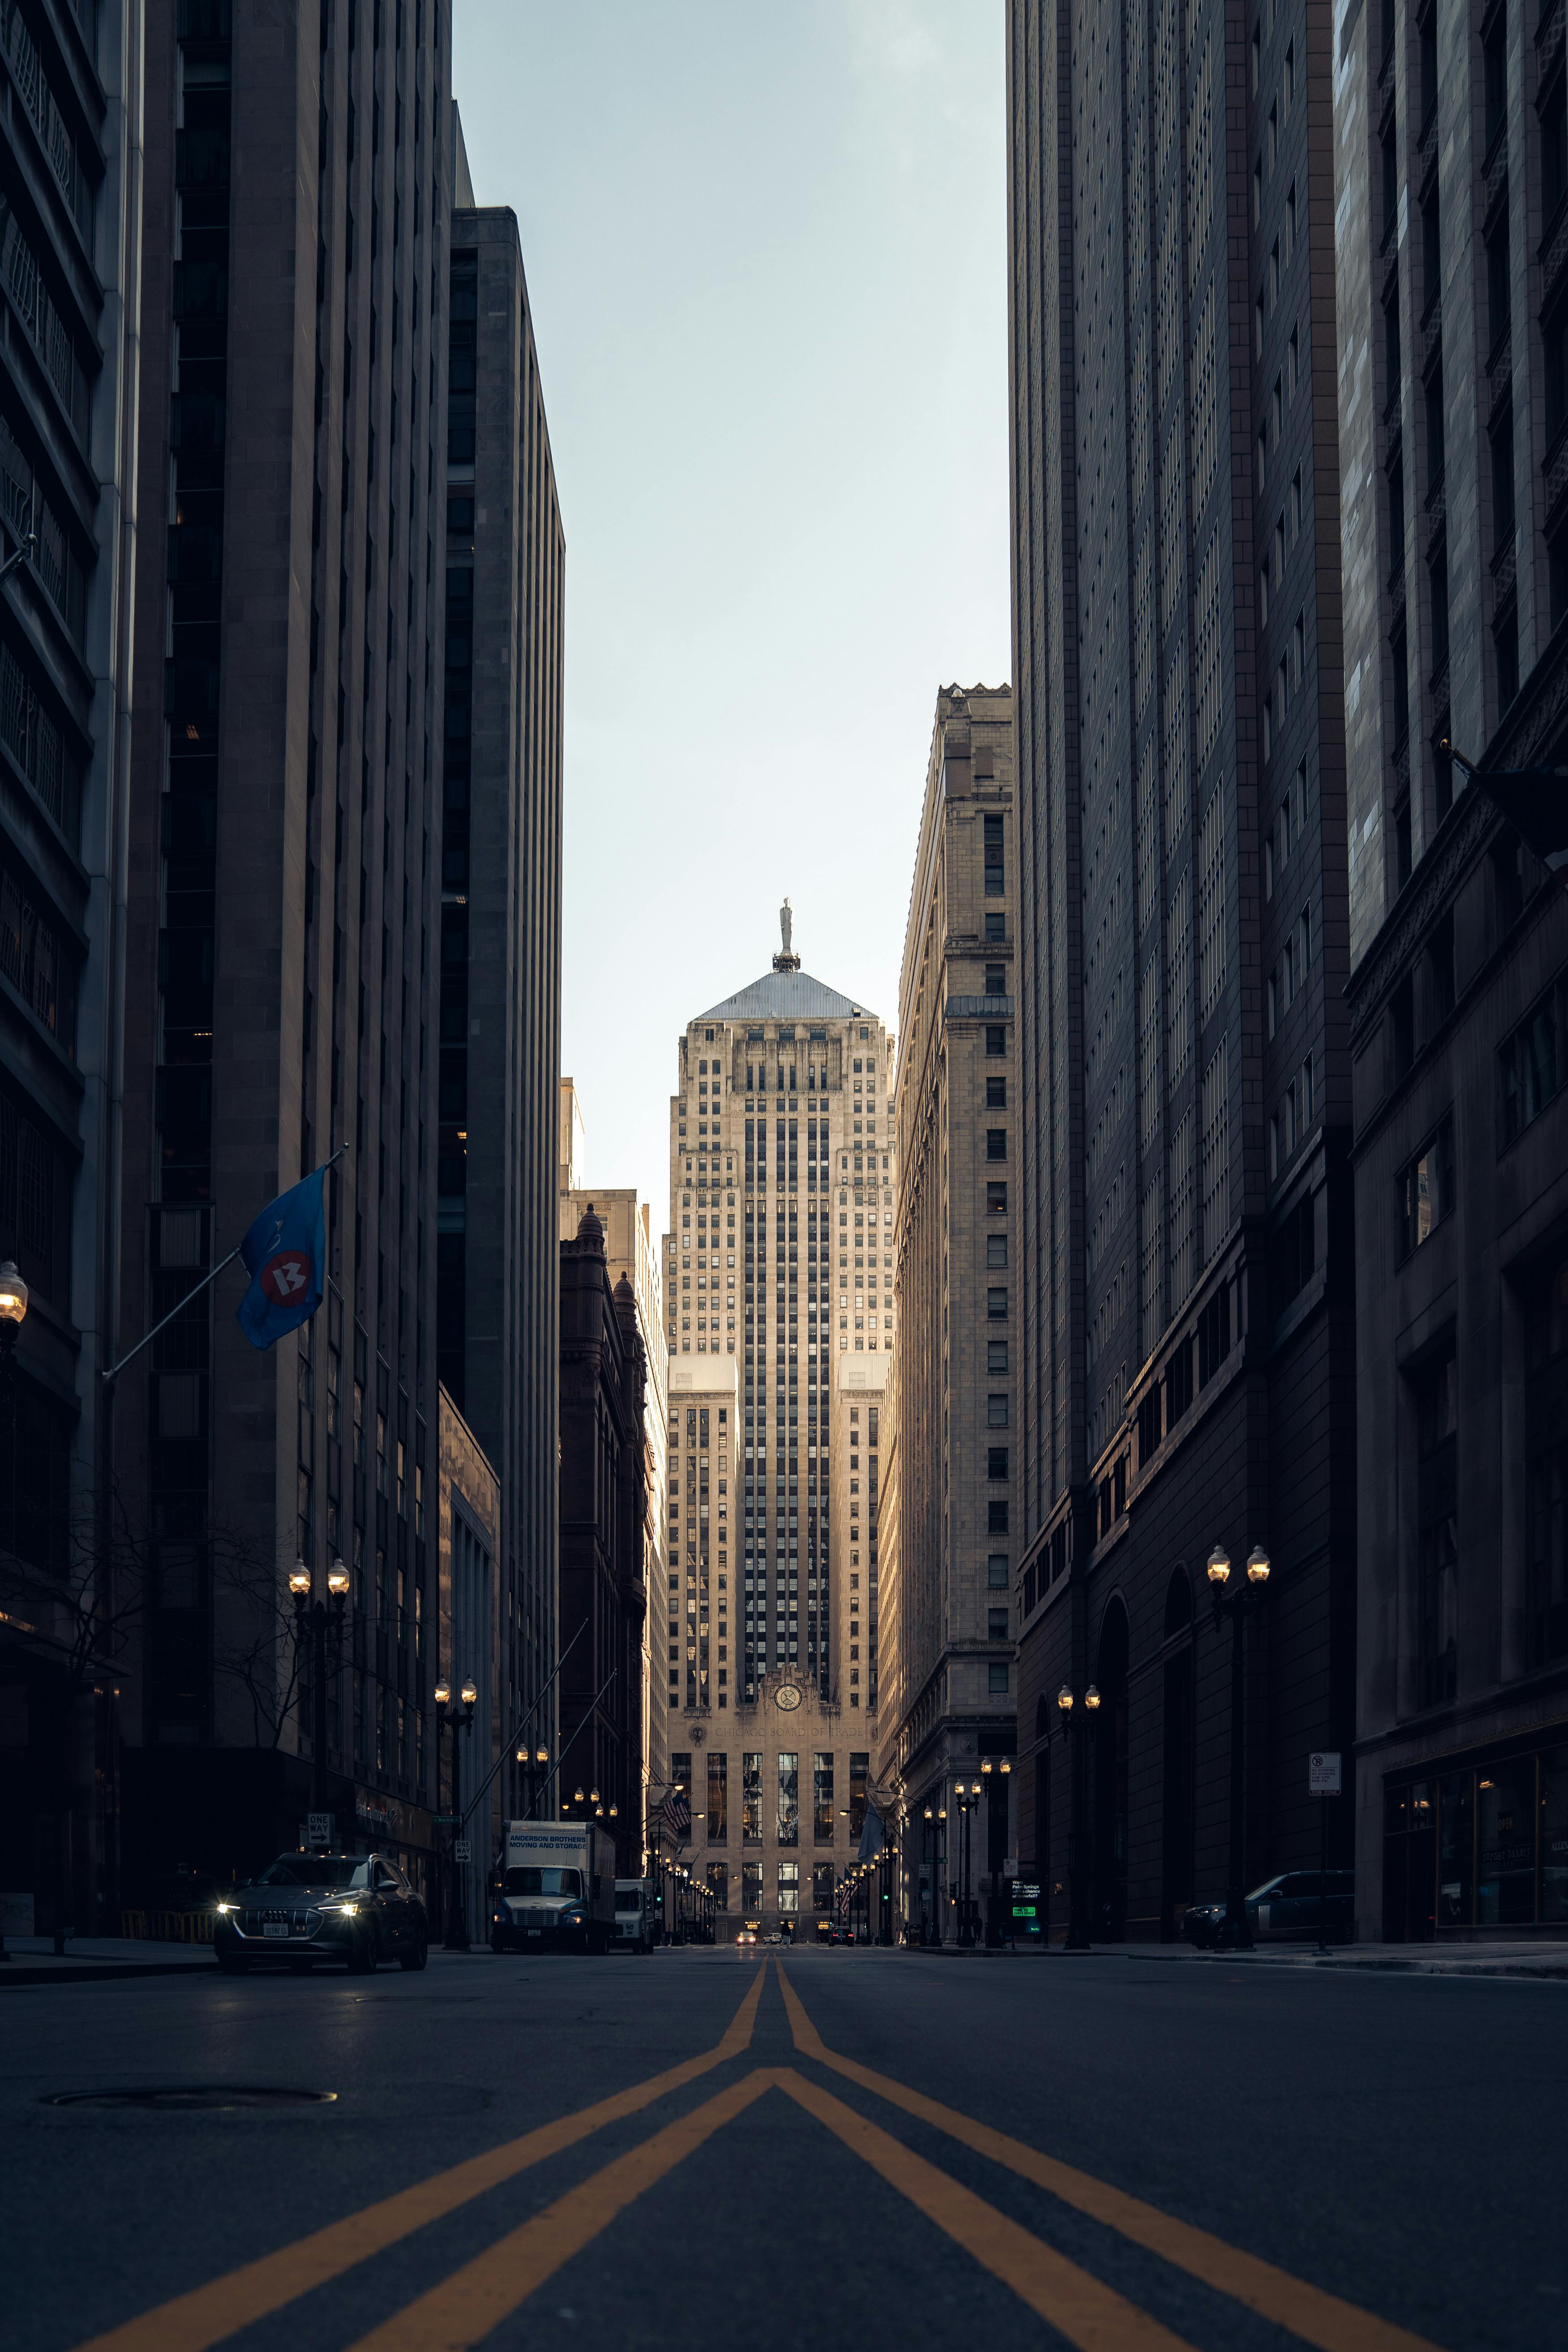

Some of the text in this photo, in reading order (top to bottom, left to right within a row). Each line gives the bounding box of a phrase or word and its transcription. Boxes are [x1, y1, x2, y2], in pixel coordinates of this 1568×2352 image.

[716, 1727, 863, 1737] CHICAGO BOARD OF TRADE
[1498, 1816, 1513, 1831] OPEN
[1483, 1847, 1531, 1862] corner bakery
